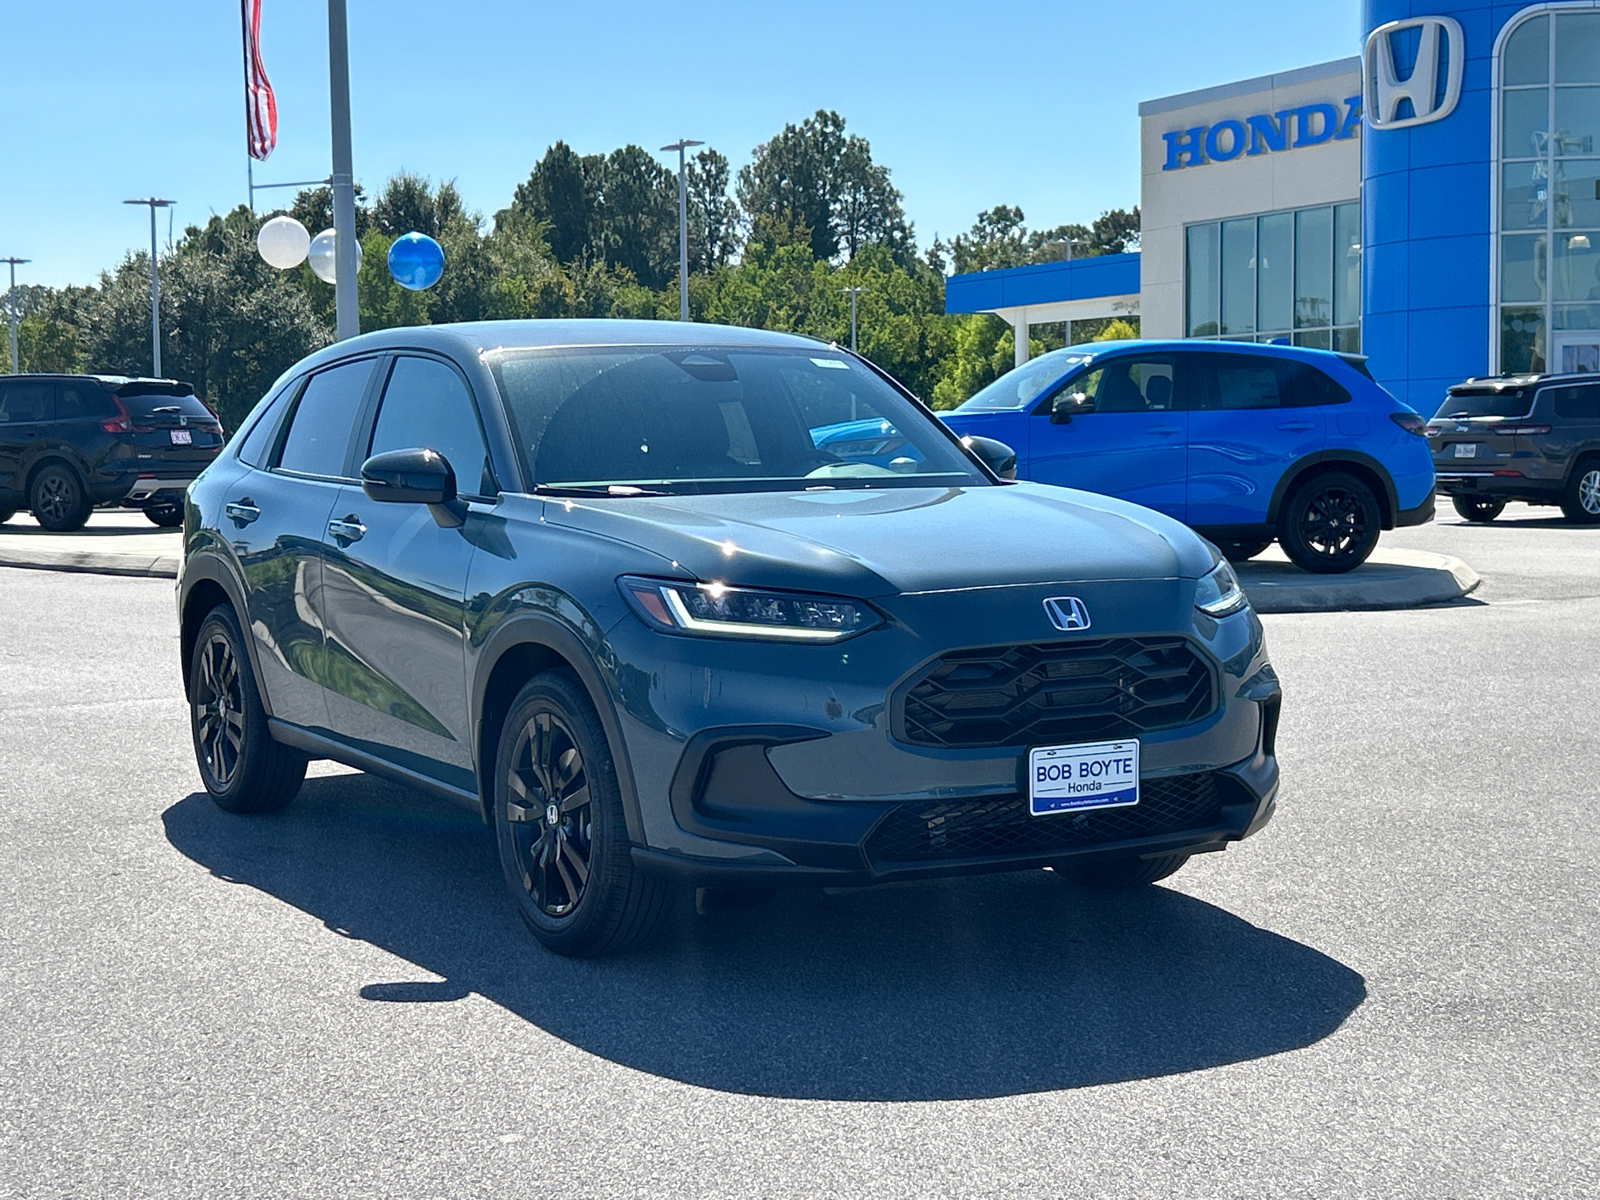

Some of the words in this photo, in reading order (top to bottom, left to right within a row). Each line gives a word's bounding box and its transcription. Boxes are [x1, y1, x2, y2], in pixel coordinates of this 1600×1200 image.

[1037, 764, 1072, 782] BOB
[1080, 758, 1133, 778] BOYTE
[1067, 780, 1102, 793] Honda
